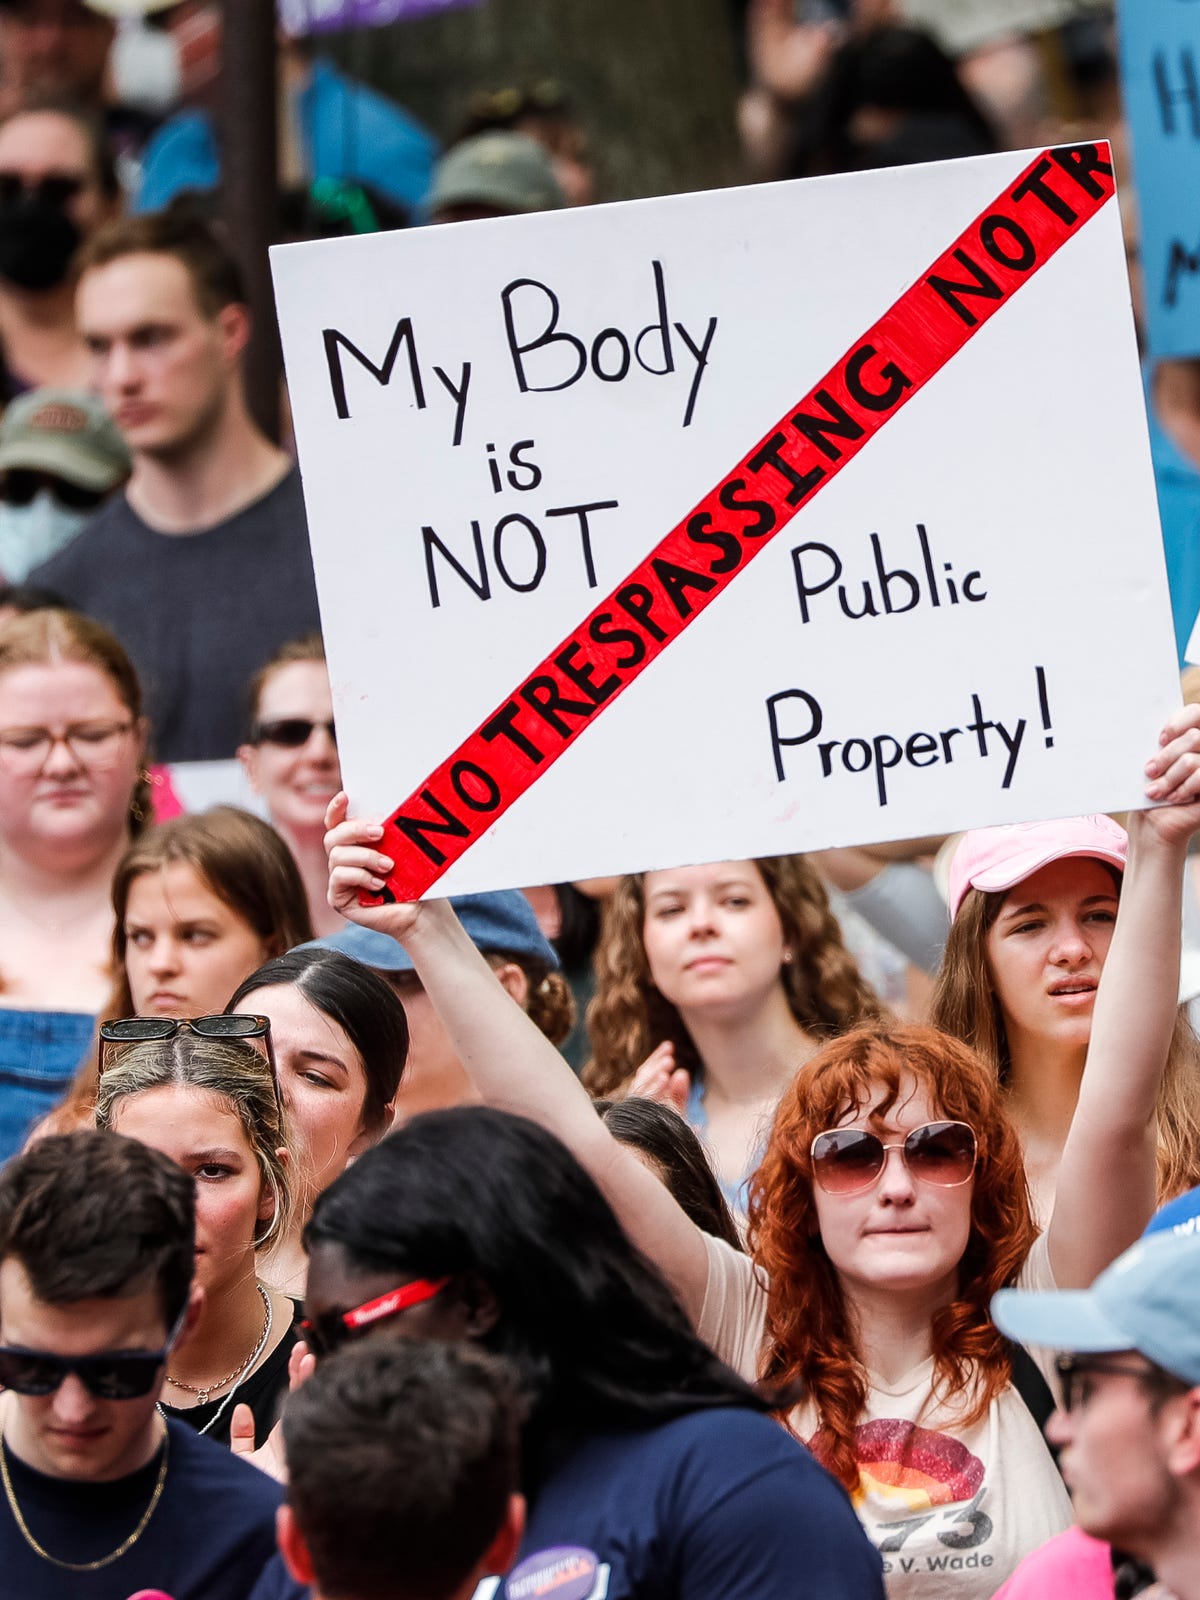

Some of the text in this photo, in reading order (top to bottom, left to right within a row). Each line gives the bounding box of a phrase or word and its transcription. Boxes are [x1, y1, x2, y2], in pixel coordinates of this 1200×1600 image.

[321, 259, 718, 447] My Body
[485, 439, 543, 494] is
[393, 760, 501, 867] NO
[478, 344, 913, 765] TRESPASSING
[926, 214, 1037, 328] NO
[420, 499, 619, 609] NOT
[790, 523, 988, 624] Public
[765, 665, 1055, 807] Property!
[899, 1558, 920, 1575] V.
[926, 1552, 994, 1572] Wade
